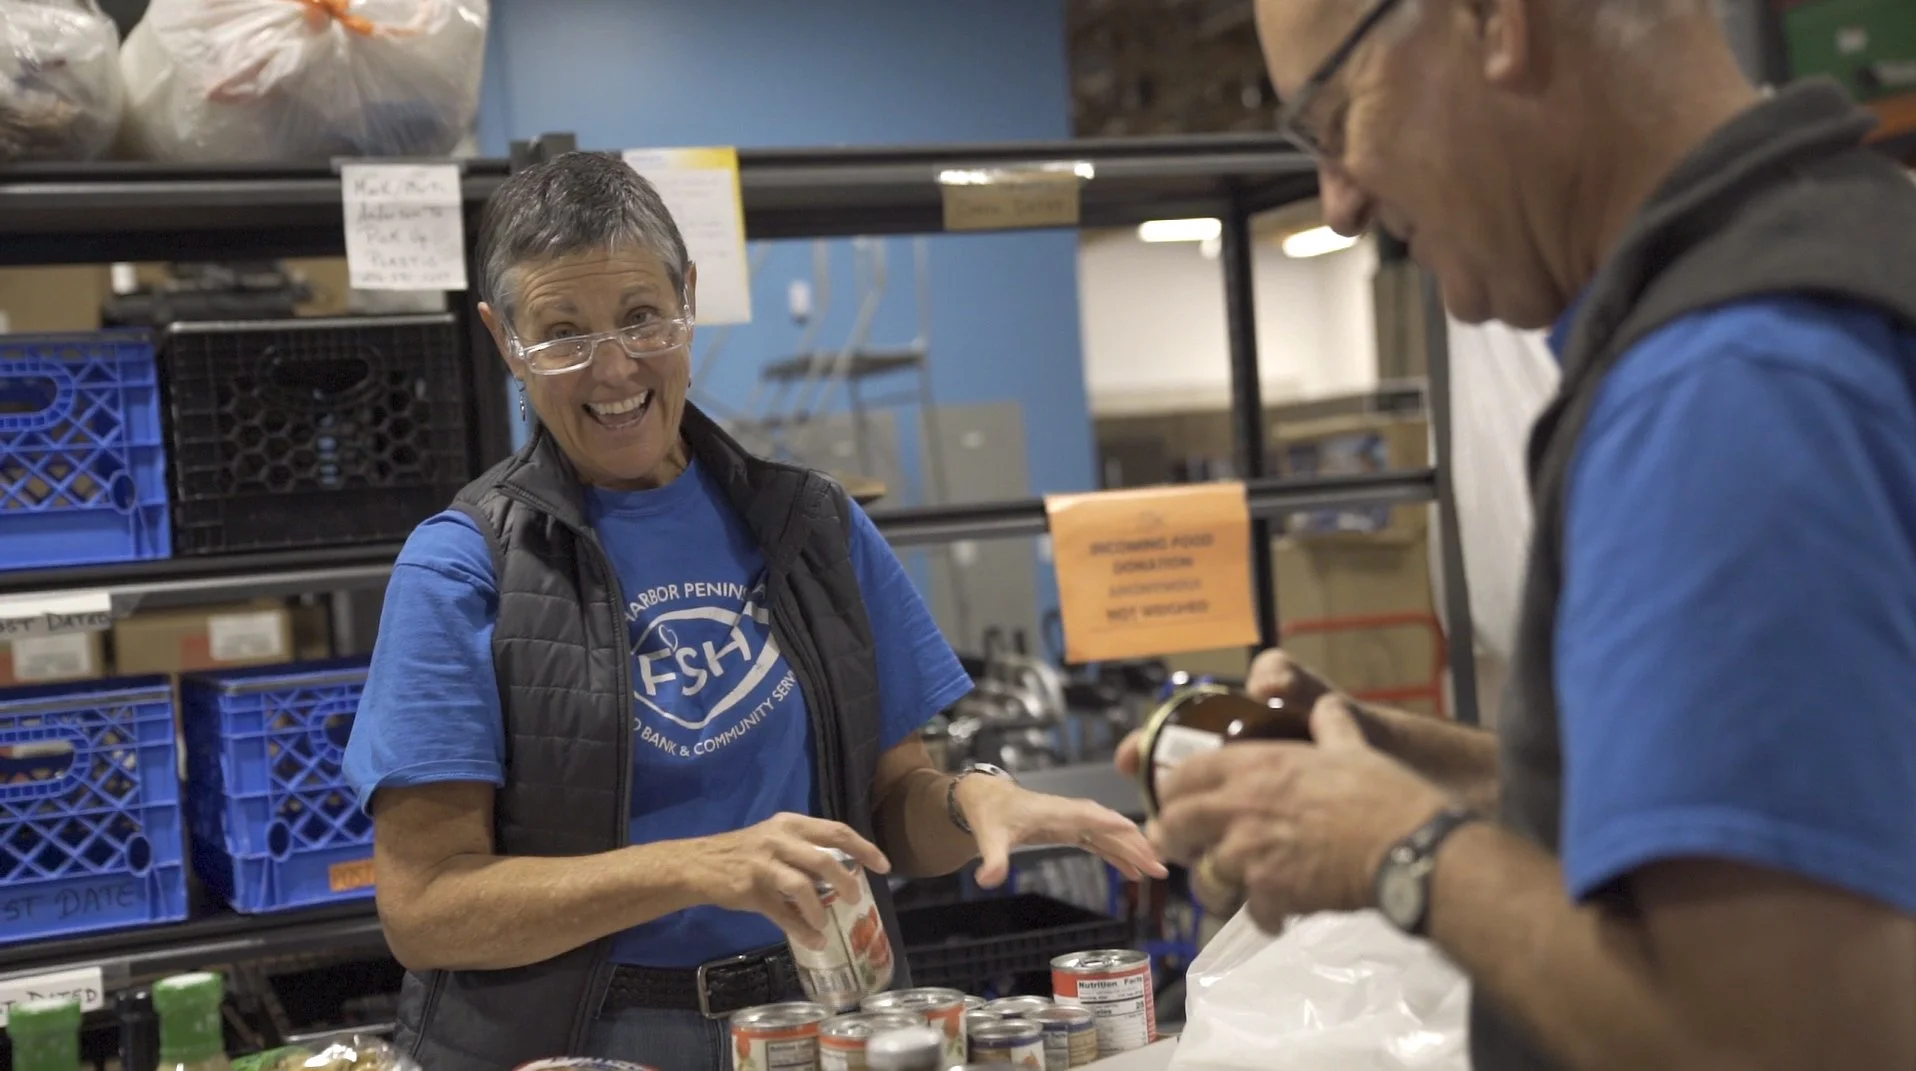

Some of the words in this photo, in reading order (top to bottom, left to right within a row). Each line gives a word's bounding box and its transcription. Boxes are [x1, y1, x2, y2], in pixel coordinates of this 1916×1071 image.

[641, 726, 677, 756] BANK
[680, 746, 690, 757] &
[694, 697, 774, 755] COMMUNITY
[1079, 980, 1118, 989] Nutrition
